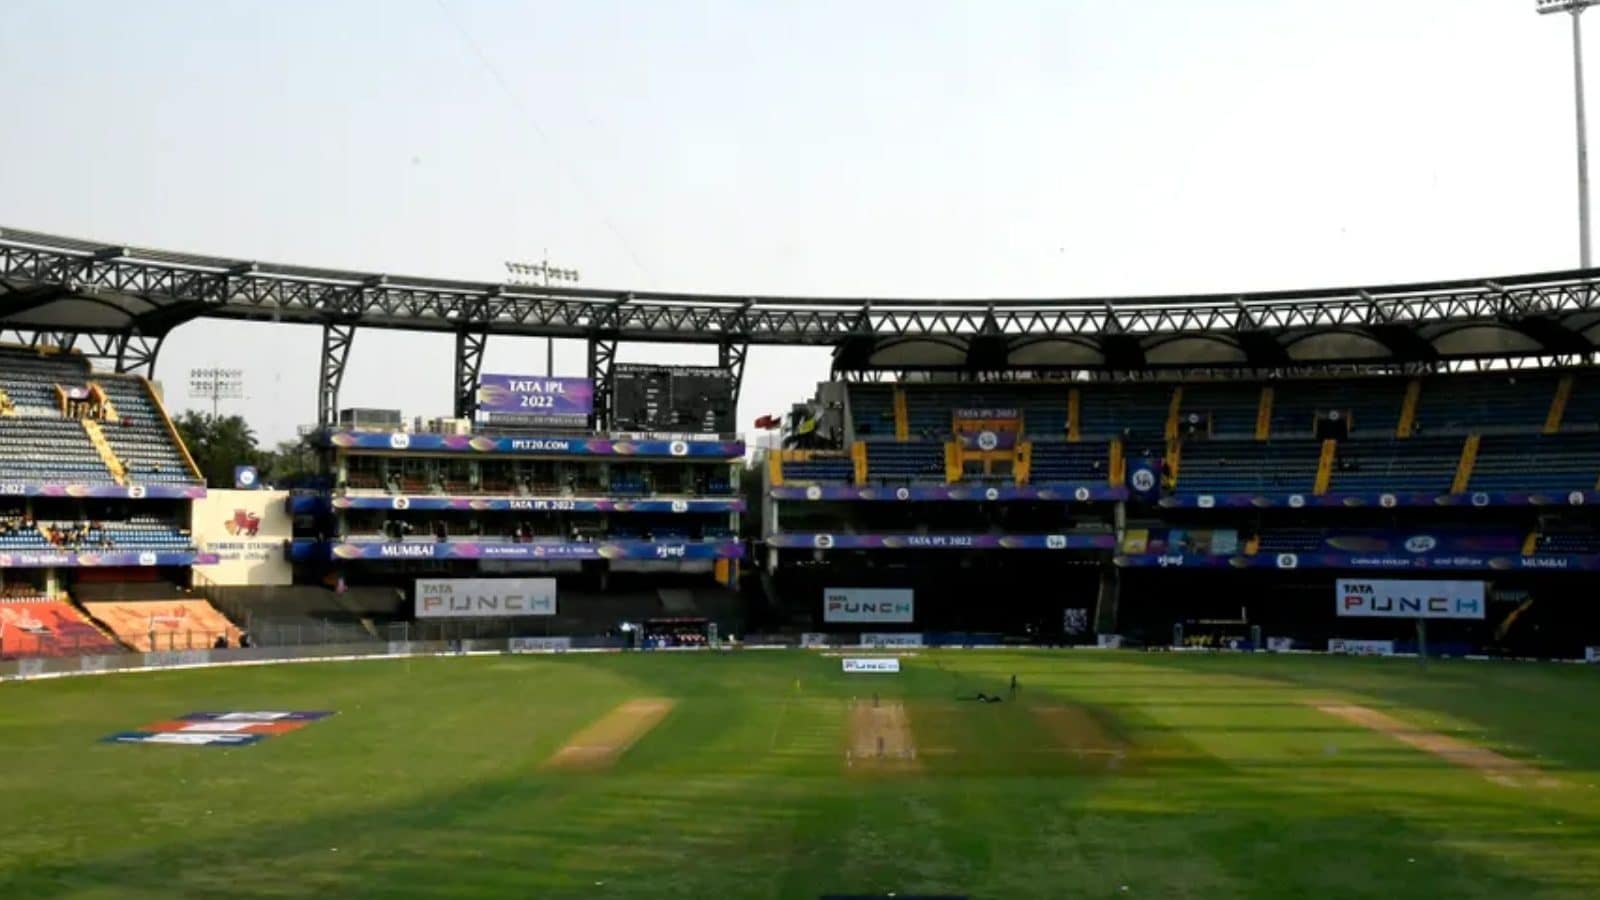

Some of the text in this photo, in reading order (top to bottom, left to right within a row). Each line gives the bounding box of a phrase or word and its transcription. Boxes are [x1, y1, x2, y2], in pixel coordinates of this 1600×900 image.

[509, 380, 565, 394] TATA IPL
[520, 395, 553, 408] 2022
[958, 408, 978, 418] TATA
[512, 440, 569, 451] IPLT20.COM
[510, 500, 576, 511] TATA IPL 2022
[908, 536, 972, 546] TATA IPL 2022
[381, 544, 435, 557] MUMBAI
[1522, 558, 1568, 569] MUMBAI
[423, 584, 453, 594] TATA
[1343, 584, 1375, 594] TATA
[424, 595, 549, 612] PUNCH
[829, 603, 910, 614] PUNCH
[1344, 597, 1478, 613] PUNCH
